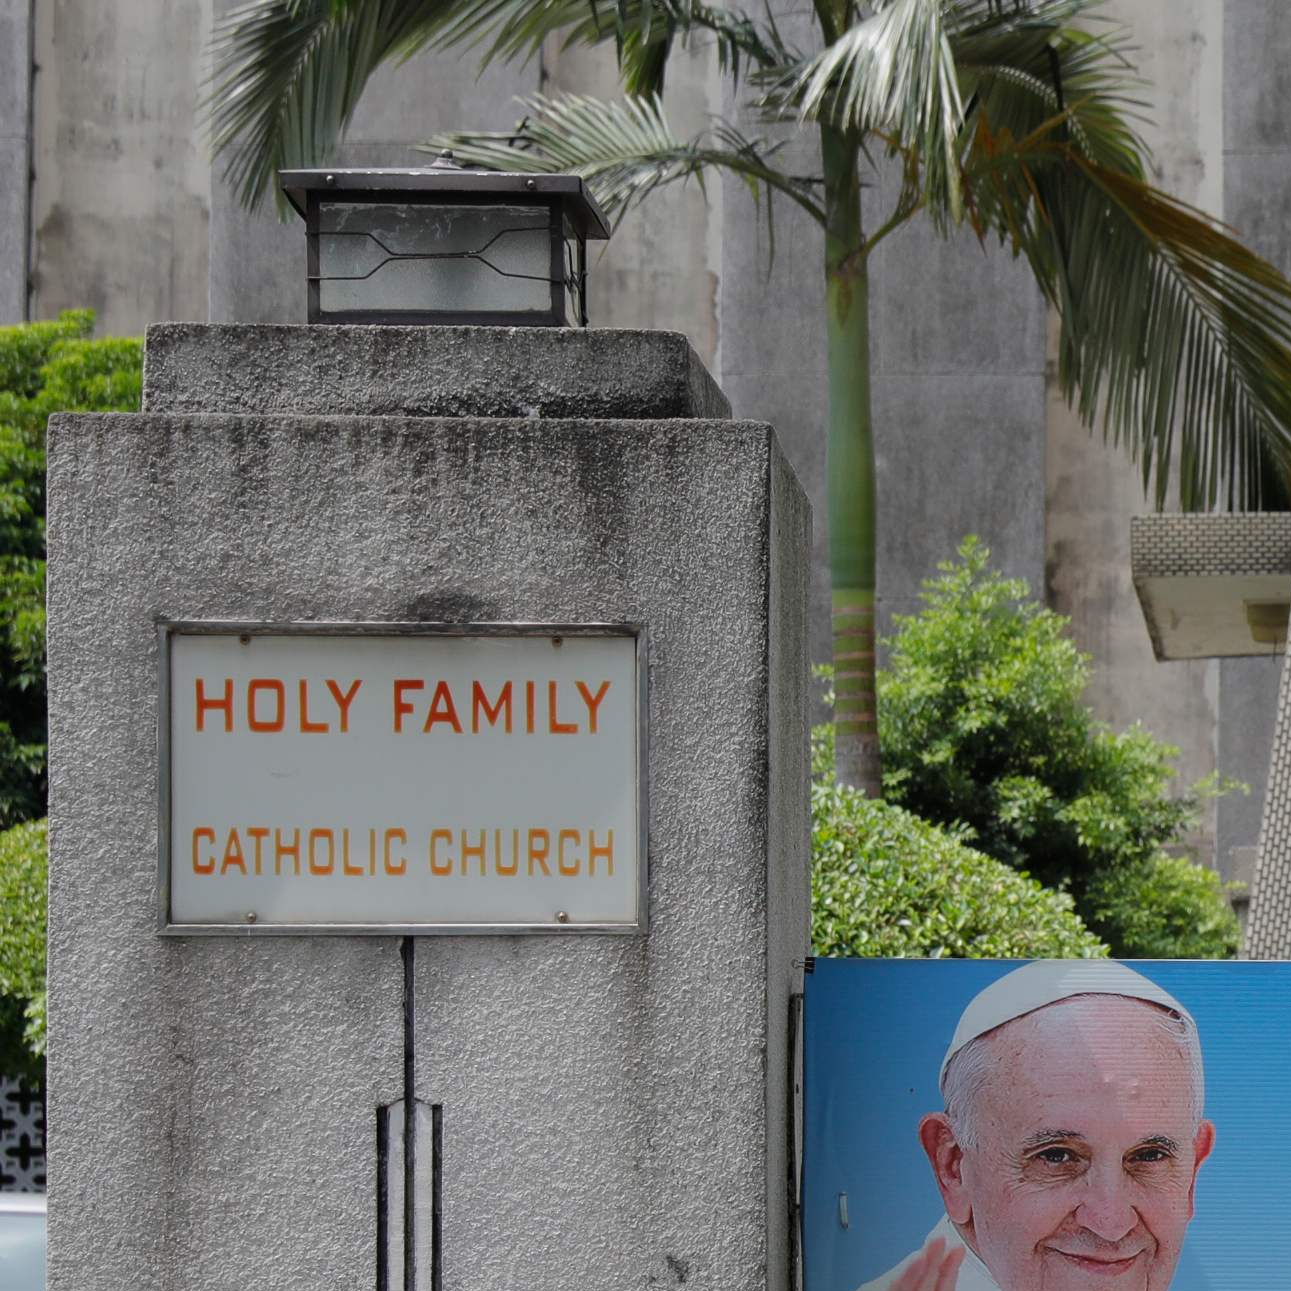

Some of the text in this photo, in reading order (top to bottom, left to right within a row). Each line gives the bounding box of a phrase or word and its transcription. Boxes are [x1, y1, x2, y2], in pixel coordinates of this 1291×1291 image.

[195, 678, 611, 734] HOLY FAMILY
[191, 827, 615, 877] CATHOLIC CHURCH
